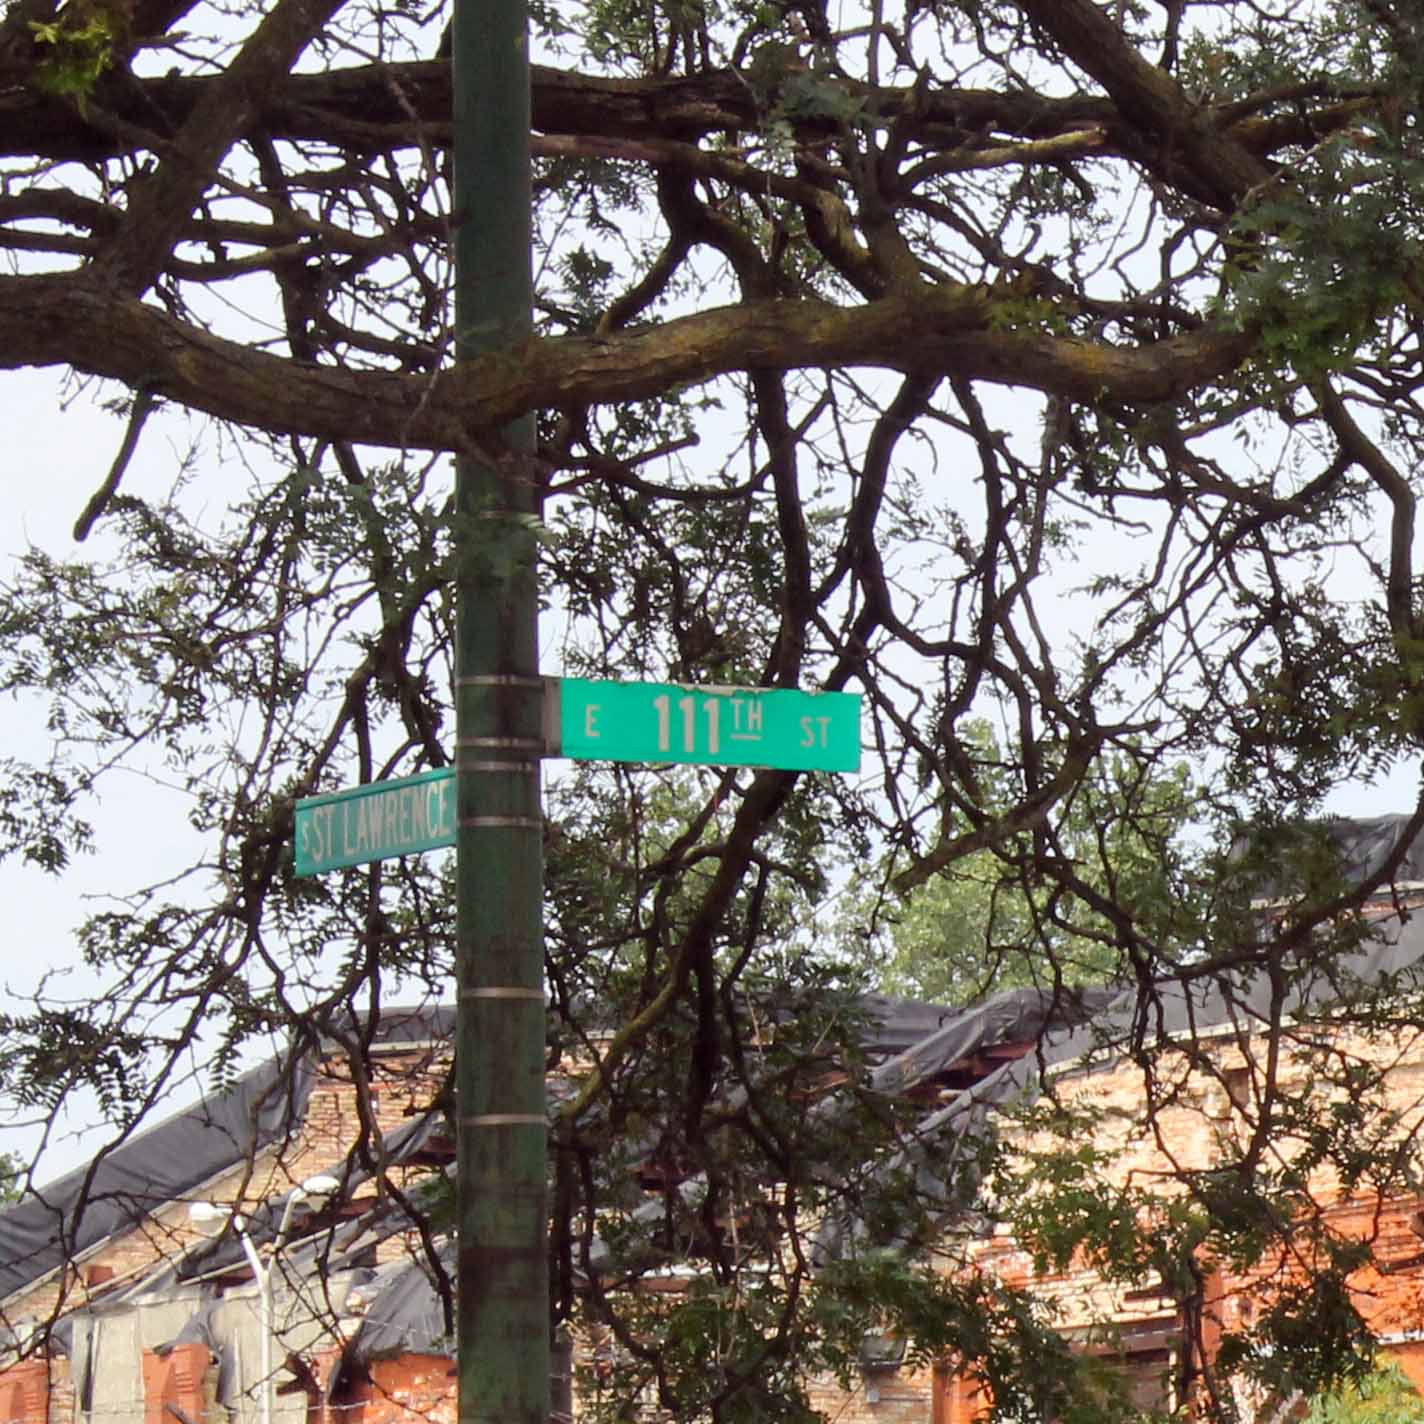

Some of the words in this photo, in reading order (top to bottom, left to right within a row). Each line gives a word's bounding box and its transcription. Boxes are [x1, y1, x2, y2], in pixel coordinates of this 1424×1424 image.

[585, 704, 600, 738] E
[654, 694, 763, 755] 111TH
[800, 716, 833, 749] ST
[312, 804, 336, 864] ST
[343, 778, 451, 858] LAWRENCE
